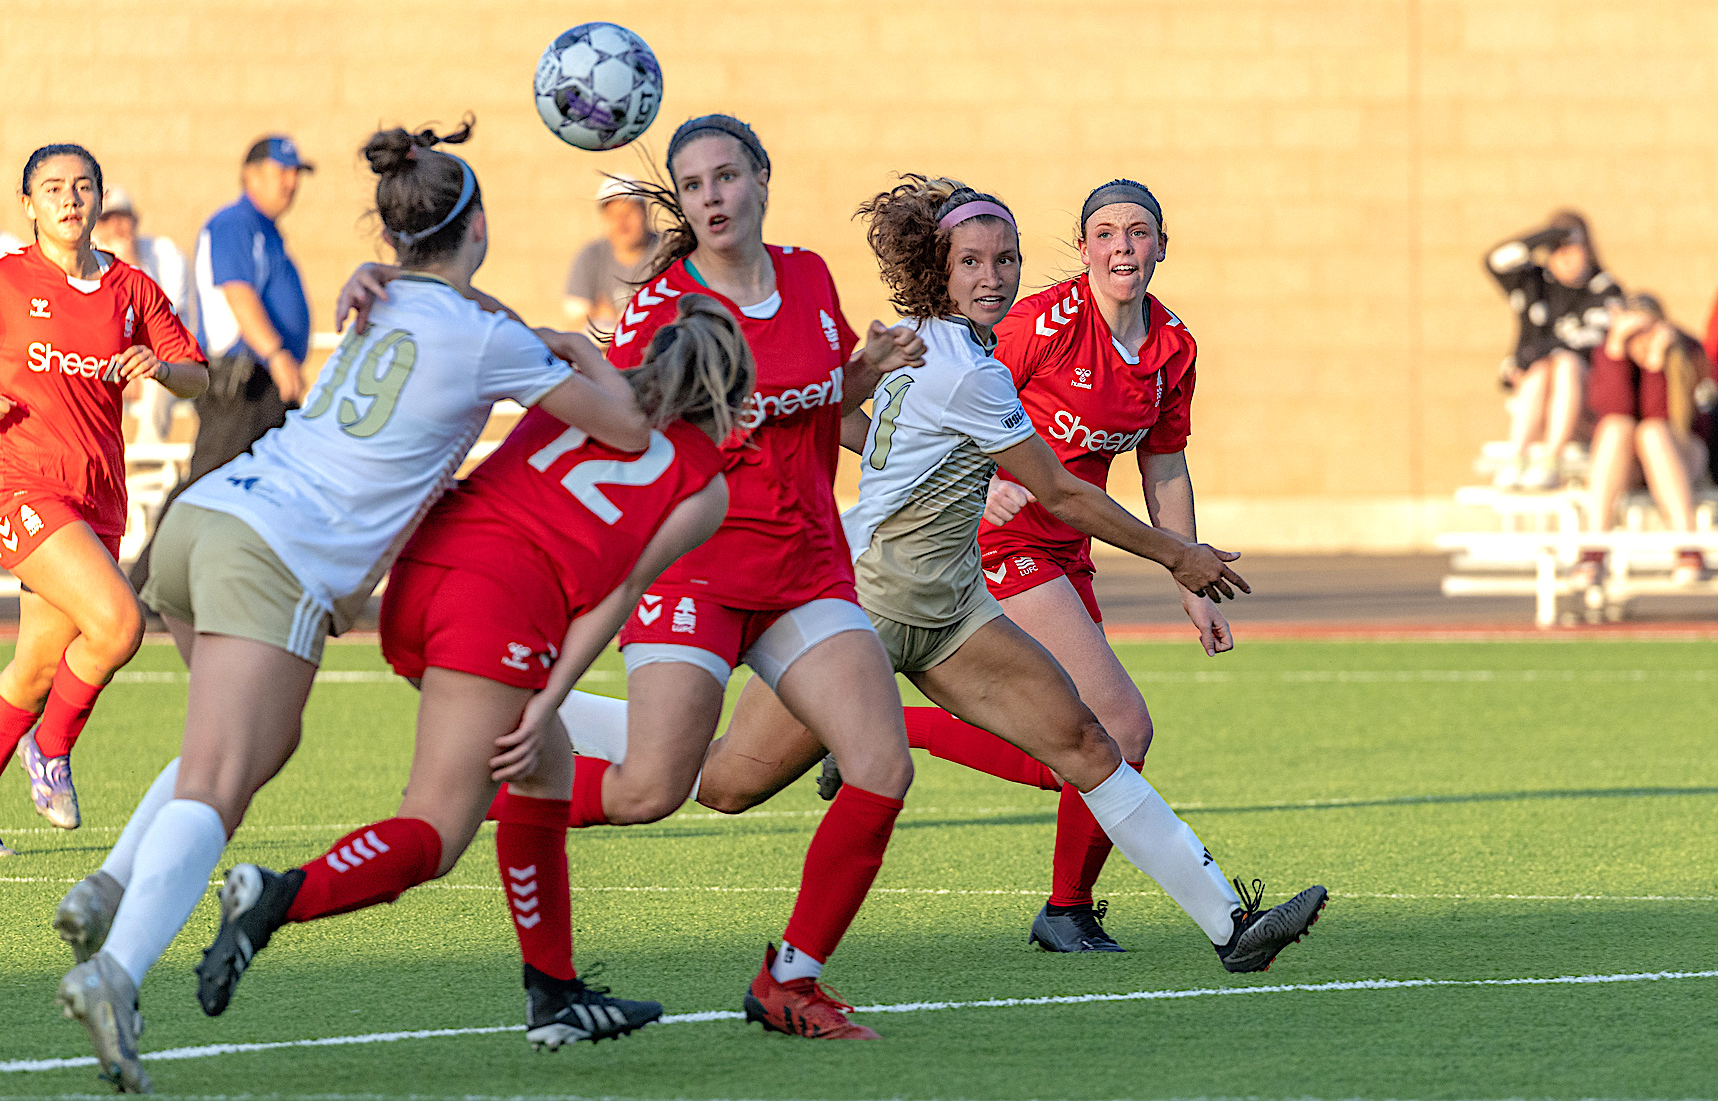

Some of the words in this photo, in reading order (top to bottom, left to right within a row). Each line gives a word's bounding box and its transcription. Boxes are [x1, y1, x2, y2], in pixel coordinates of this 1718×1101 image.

[869, 372, 915, 471] 1
[526, 425, 676, 526] 12
[1019, 564, 1039, 577] LUFC
